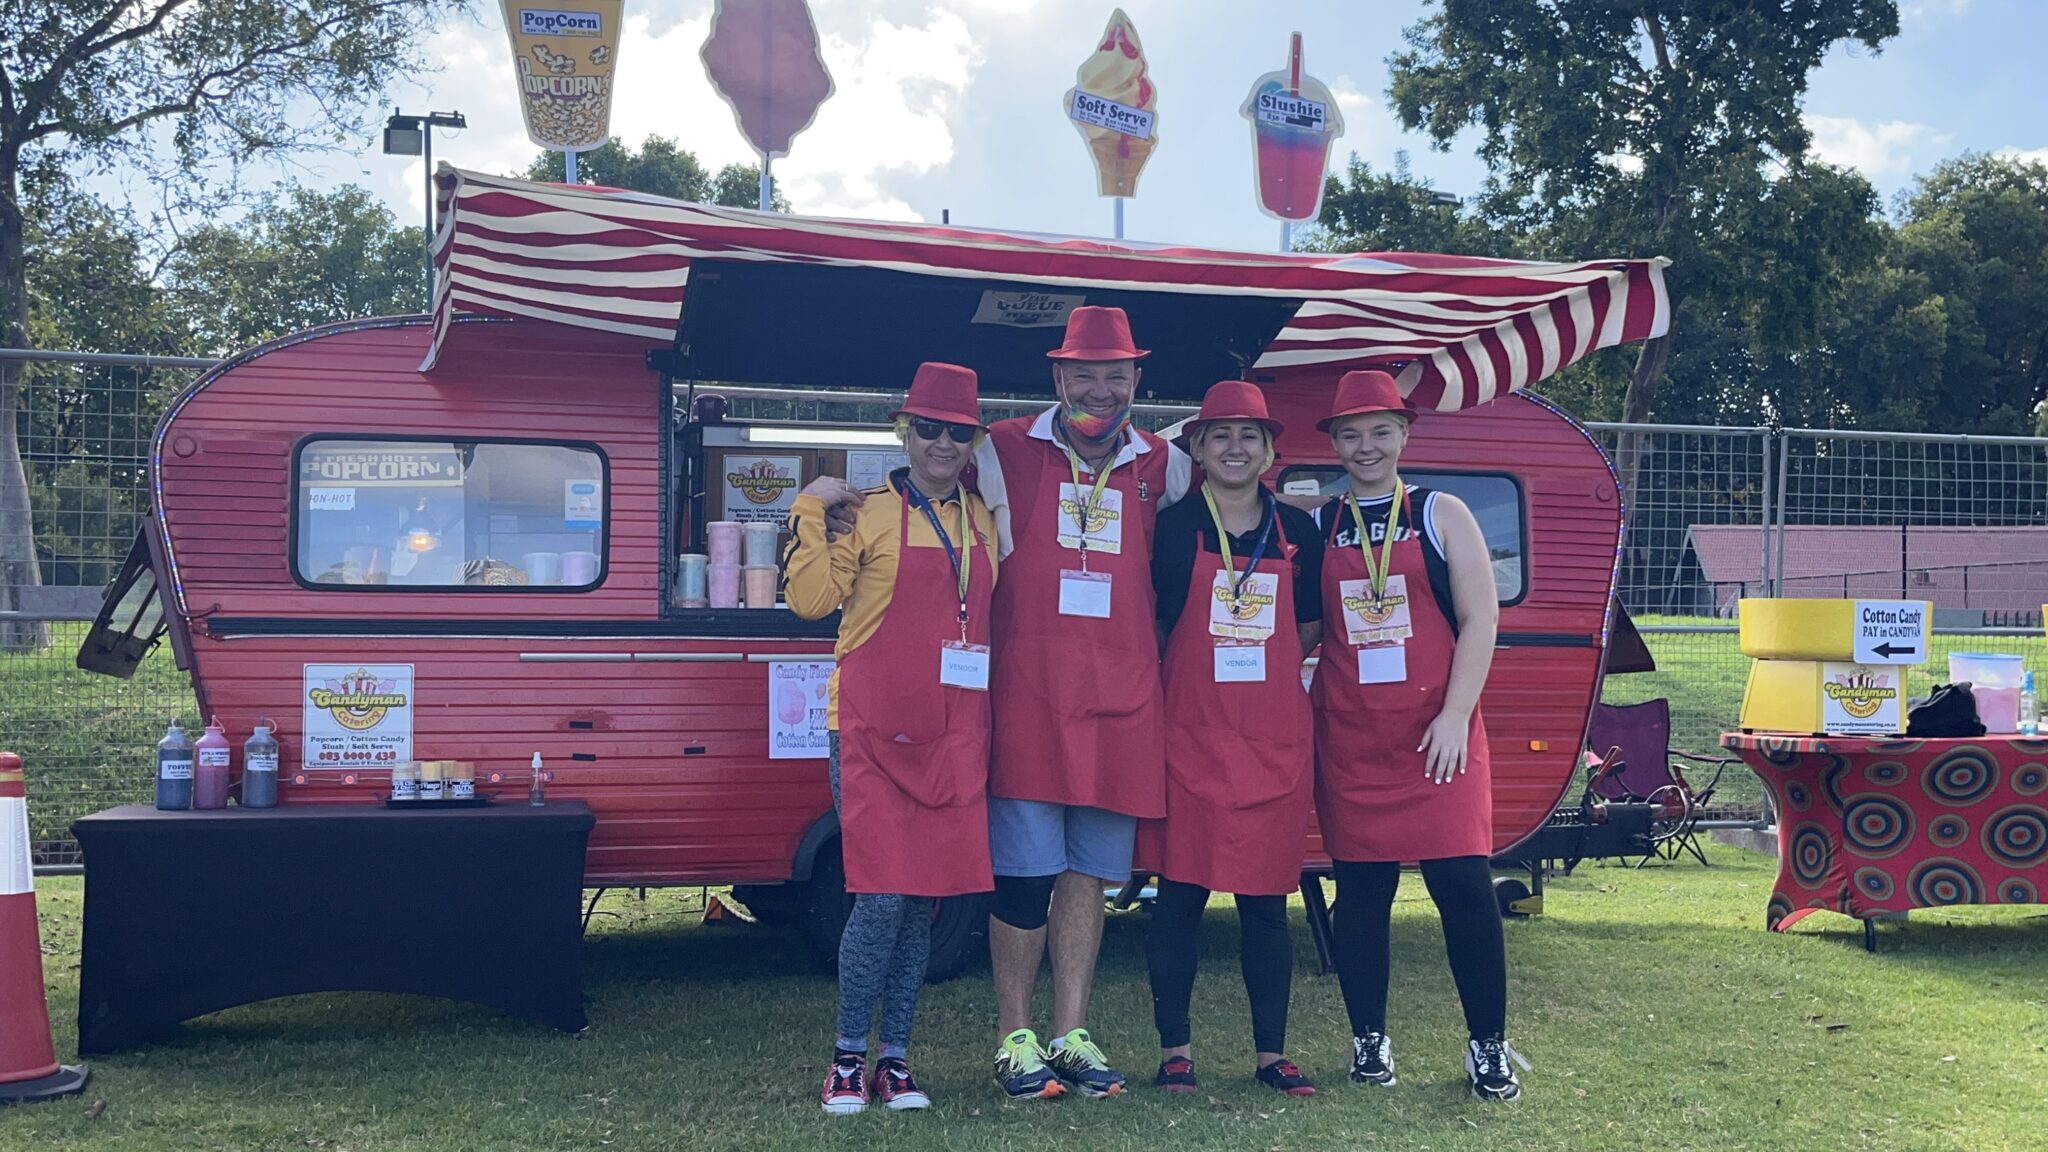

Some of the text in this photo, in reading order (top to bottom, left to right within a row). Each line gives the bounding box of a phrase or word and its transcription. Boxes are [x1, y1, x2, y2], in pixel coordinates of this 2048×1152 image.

[523, 12, 597, 30] PopCorn
[518, 56, 602, 96] POPCORN
[1077, 95, 1107, 115] Soft
[1108, 104, 1147, 127] Serve
[1261, 94, 1322, 118] Slushie
[302, 461, 440, 480] POPCORN
[728, 473, 795, 488] Candyman
[1863, 608, 1921, 626] Cotton Candy
[1863, 626, 1920, 637] PAY in CANDYVAN
[776, 664, 808, 681] Candy
[949, 663, 978, 672] VENDOR
[310, 688, 405, 708] Candyman
[1825, 683, 1895, 699] Candyman
[1846, 701, 1877, 715] Catering
[338, 710, 381, 727] Catering
[380, 735, 405, 743] Candy
[776, 731, 807, 748] Cotton
